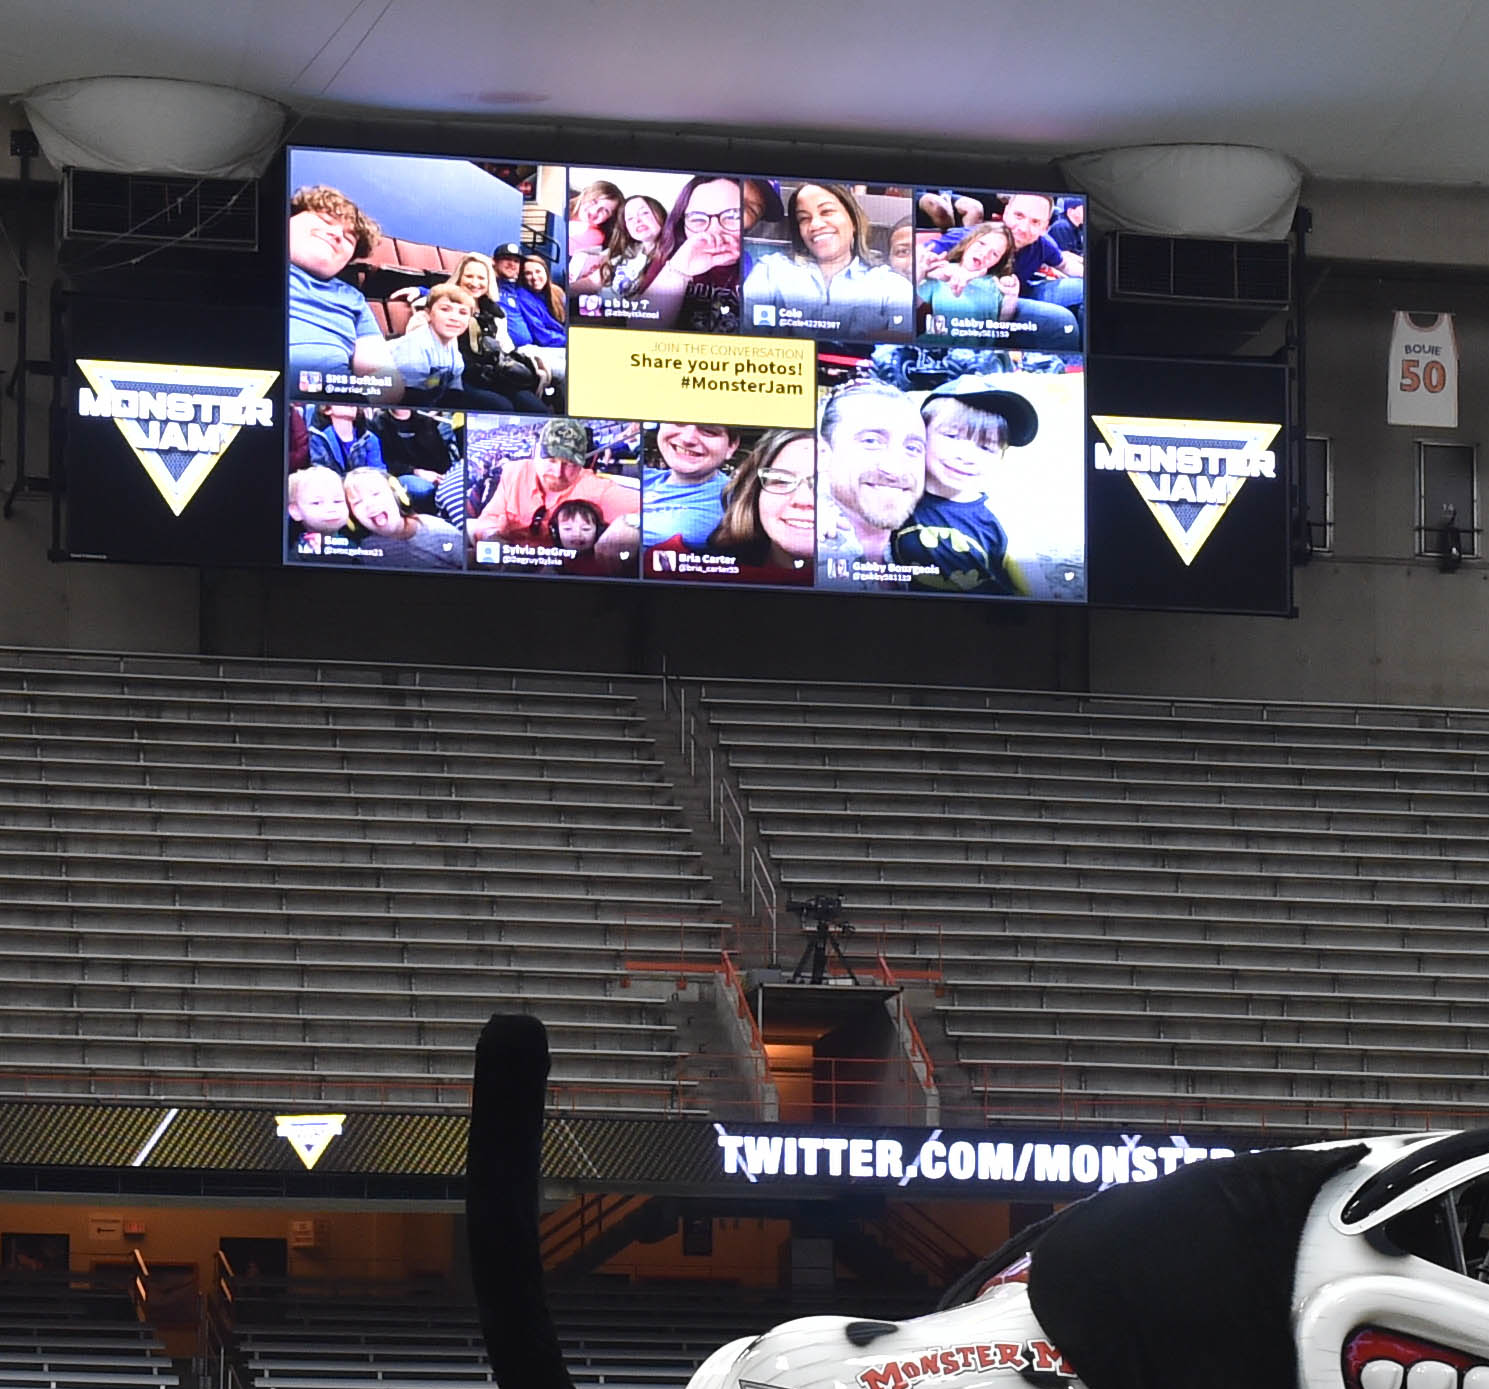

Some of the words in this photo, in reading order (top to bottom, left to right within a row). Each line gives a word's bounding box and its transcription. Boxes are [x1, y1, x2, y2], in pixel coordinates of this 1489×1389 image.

[630, 353, 683, 370] Share
[687, 359, 729, 374] your
[734, 358, 803, 376] photos!
[651, 342, 681, 354] JOIN
[684, 343, 708, 355] THE
[710, 344, 805, 360] CONVERSATION
[1404, 344, 1441, 357] BOUIE
[680, 376, 804, 395] #MonsterJam
[1400, 358, 1446, 393] 50
[79, 388, 274, 427] MONSTER
[136, 420, 221, 454] JAM
[1095, 442, 1277, 478] MONSTER
[1148, 474, 1228, 504] JAM
